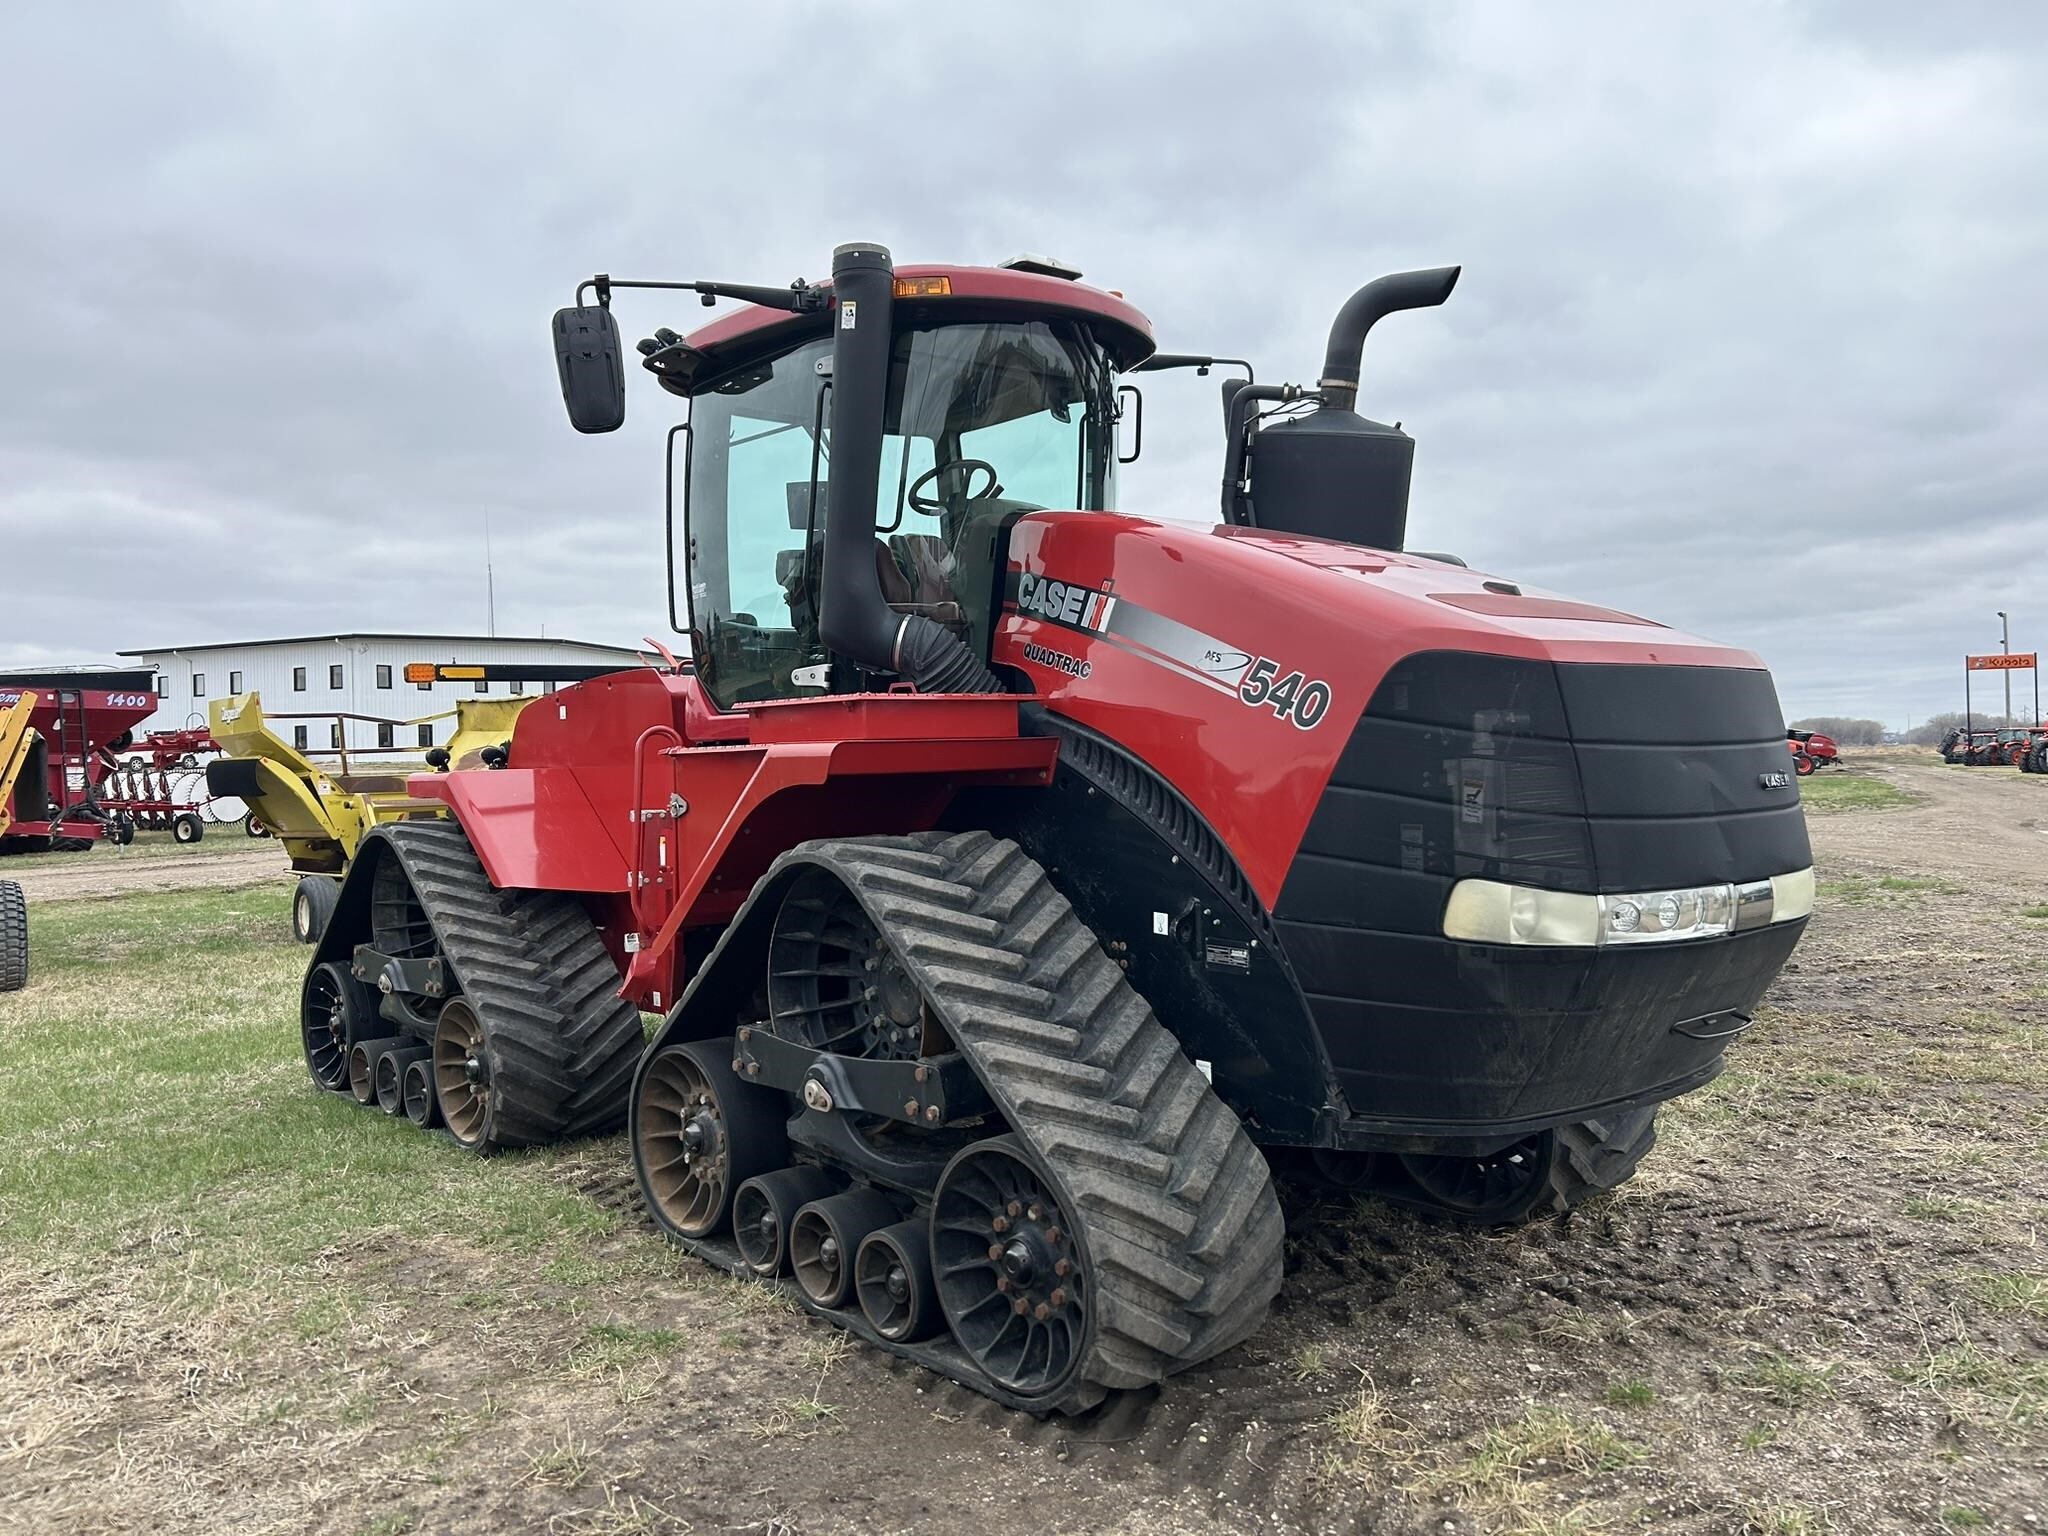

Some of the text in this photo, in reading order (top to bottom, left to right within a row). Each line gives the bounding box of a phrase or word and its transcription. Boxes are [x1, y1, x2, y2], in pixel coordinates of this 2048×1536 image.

[1018, 573, 1086, 625] CASE
[1023, 641, 1093, 680] QUADTRAC
[1204, 650, 1222, 663] AFS
[1989, 657, 2030, 667] Kubota
[106, 693, 146, 707] 1400
[1239, 656, 1332, 731] 540
